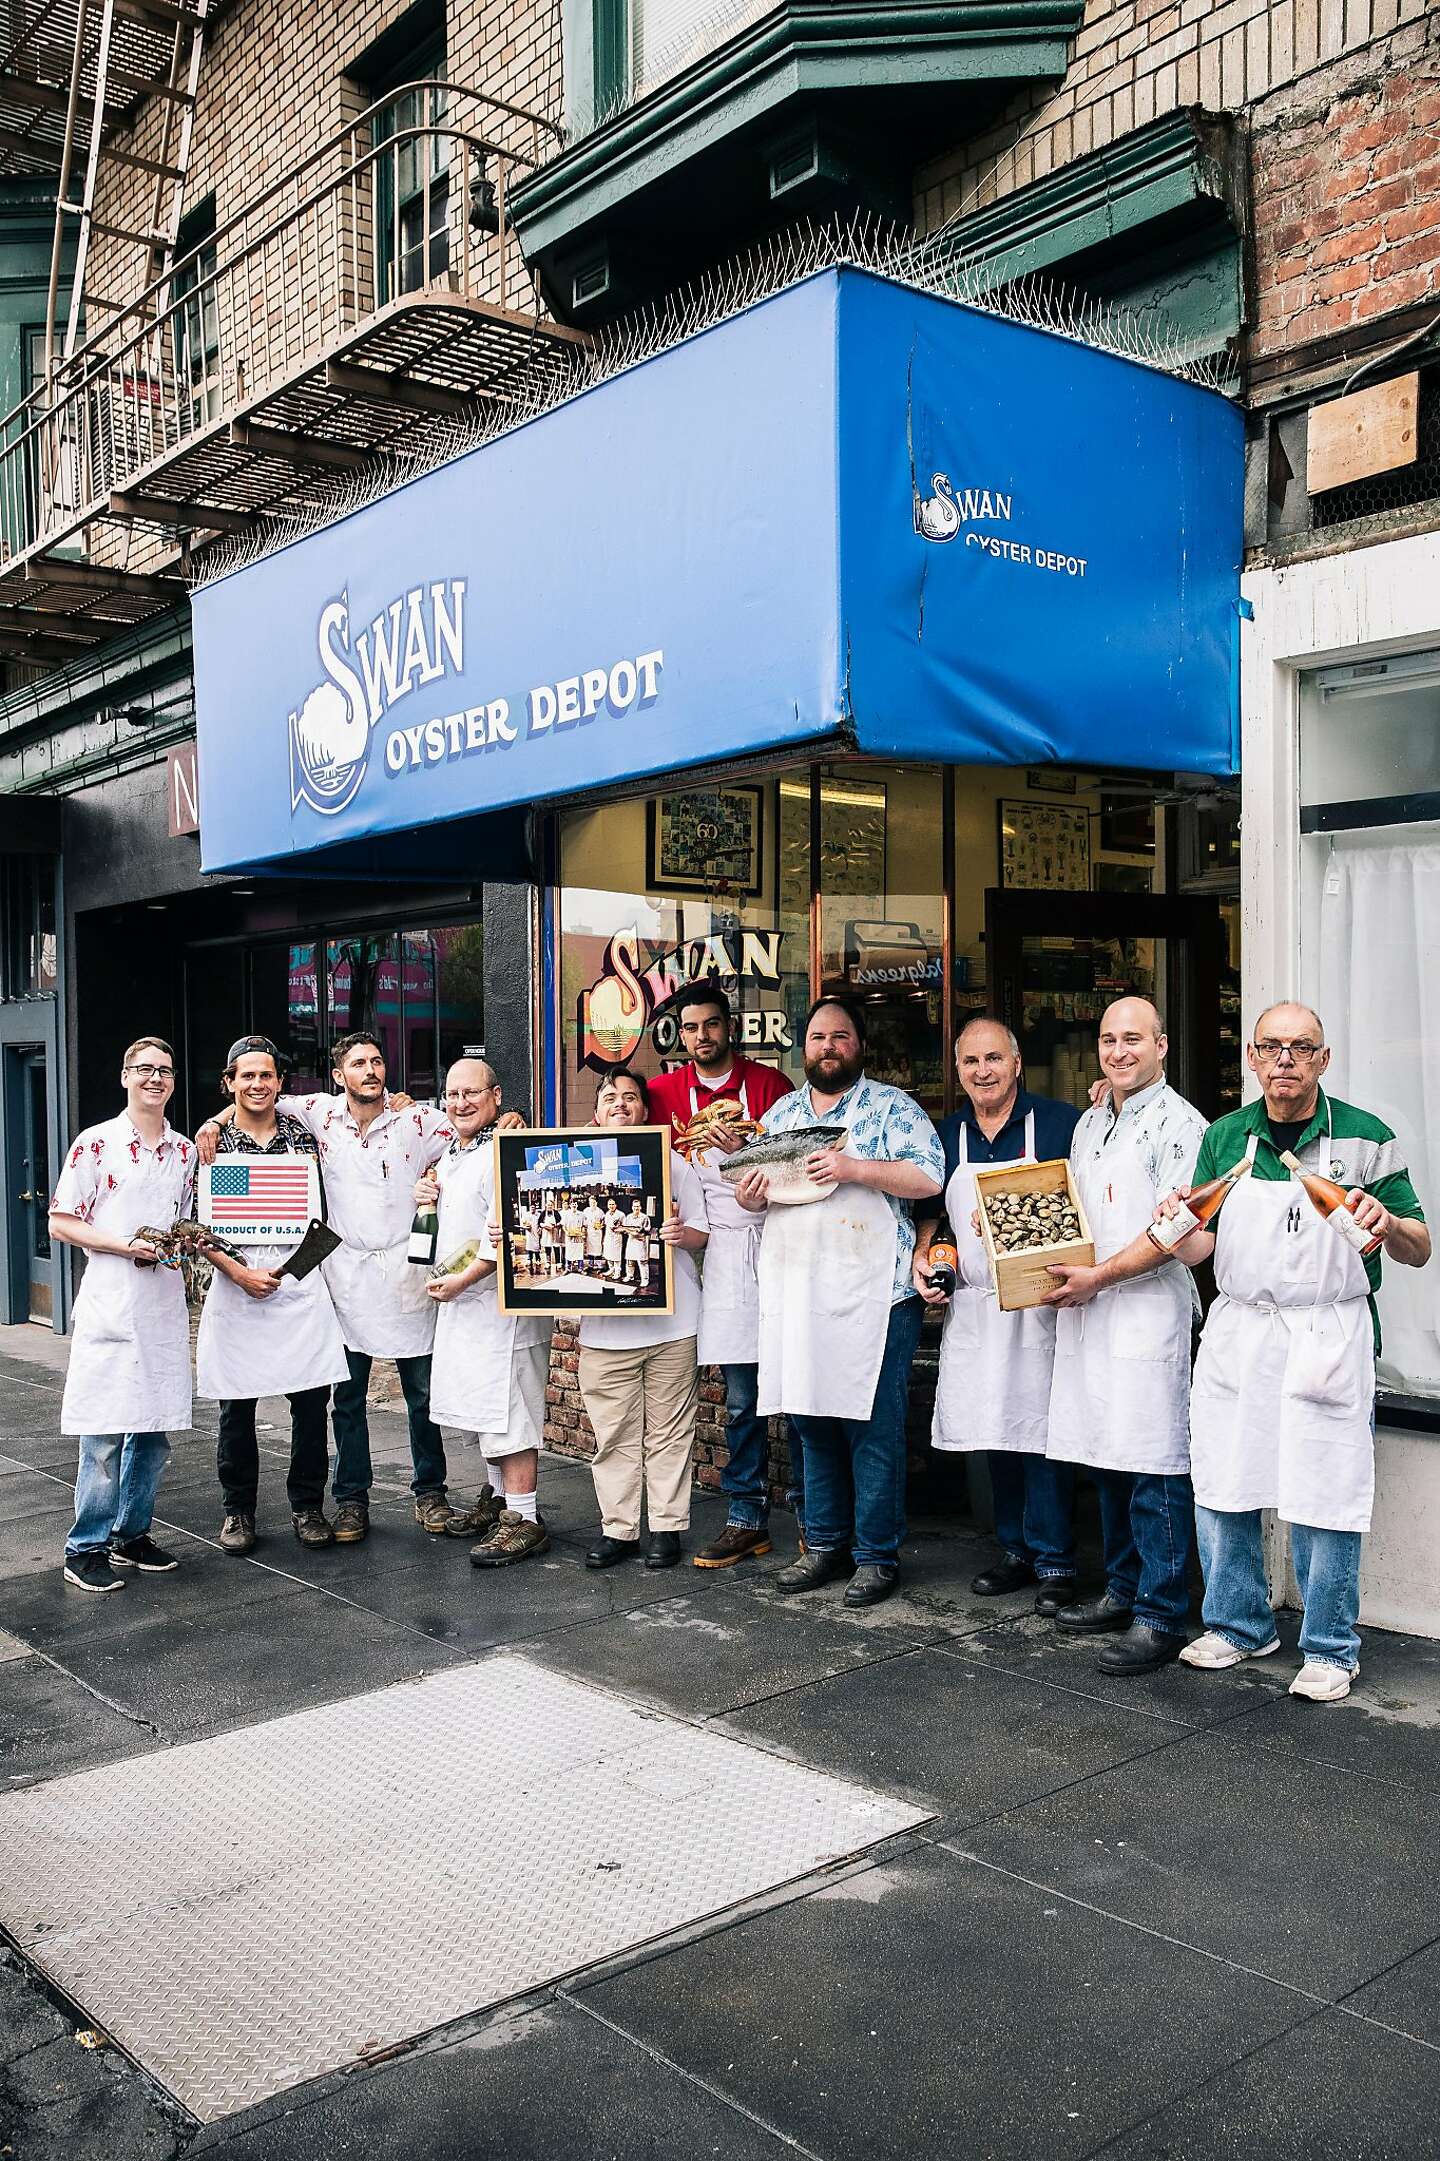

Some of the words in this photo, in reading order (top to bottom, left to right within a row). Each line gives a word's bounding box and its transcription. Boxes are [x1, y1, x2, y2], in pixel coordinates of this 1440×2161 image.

[1035, 549, 1087, 577] DEPOT
[385, 698, 518, 775] OYSTER
[527, 650, 664, 737] DEPOT
[653, 1010, 793, 1053] OER
[212, 1226, 257, 1234] PRODUCT
[260, 1226, 272, 1234] OF
[275, 1226, 305, 1234] U.S.A.
